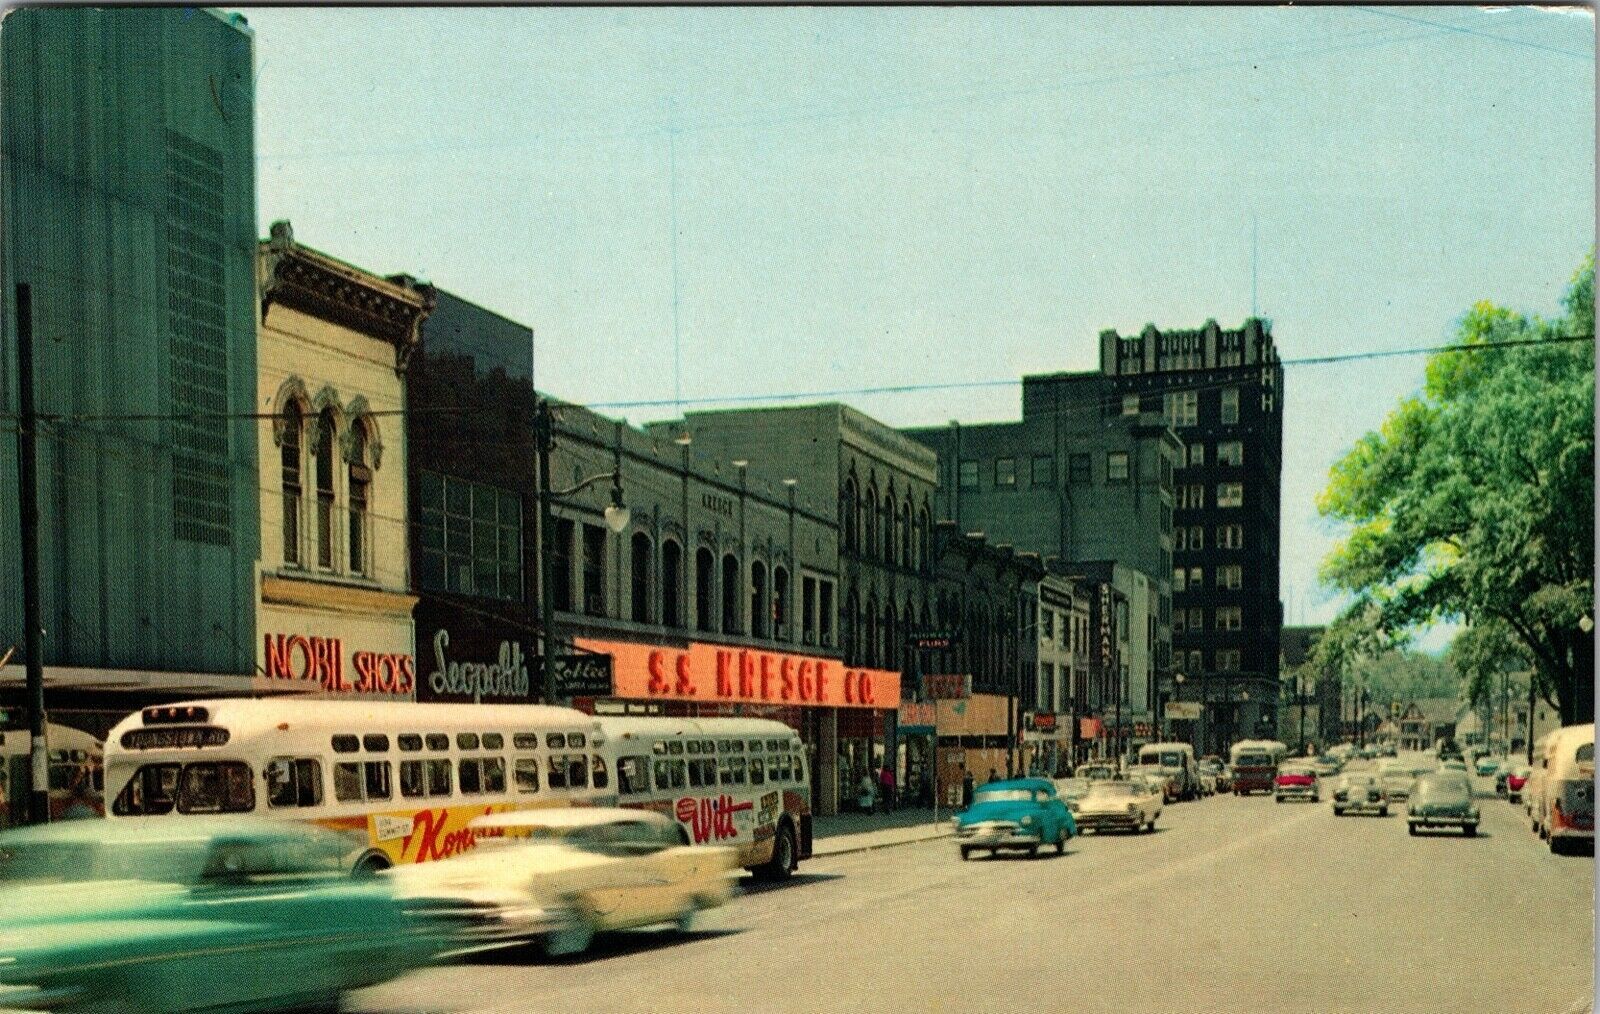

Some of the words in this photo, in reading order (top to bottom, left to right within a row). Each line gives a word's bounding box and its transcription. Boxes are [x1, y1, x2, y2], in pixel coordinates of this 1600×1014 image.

[264, 633, 352, 693] NOBIL
[353, 650, 414, 694] SHOES
[716, 649, 829, 703] KRESGE
